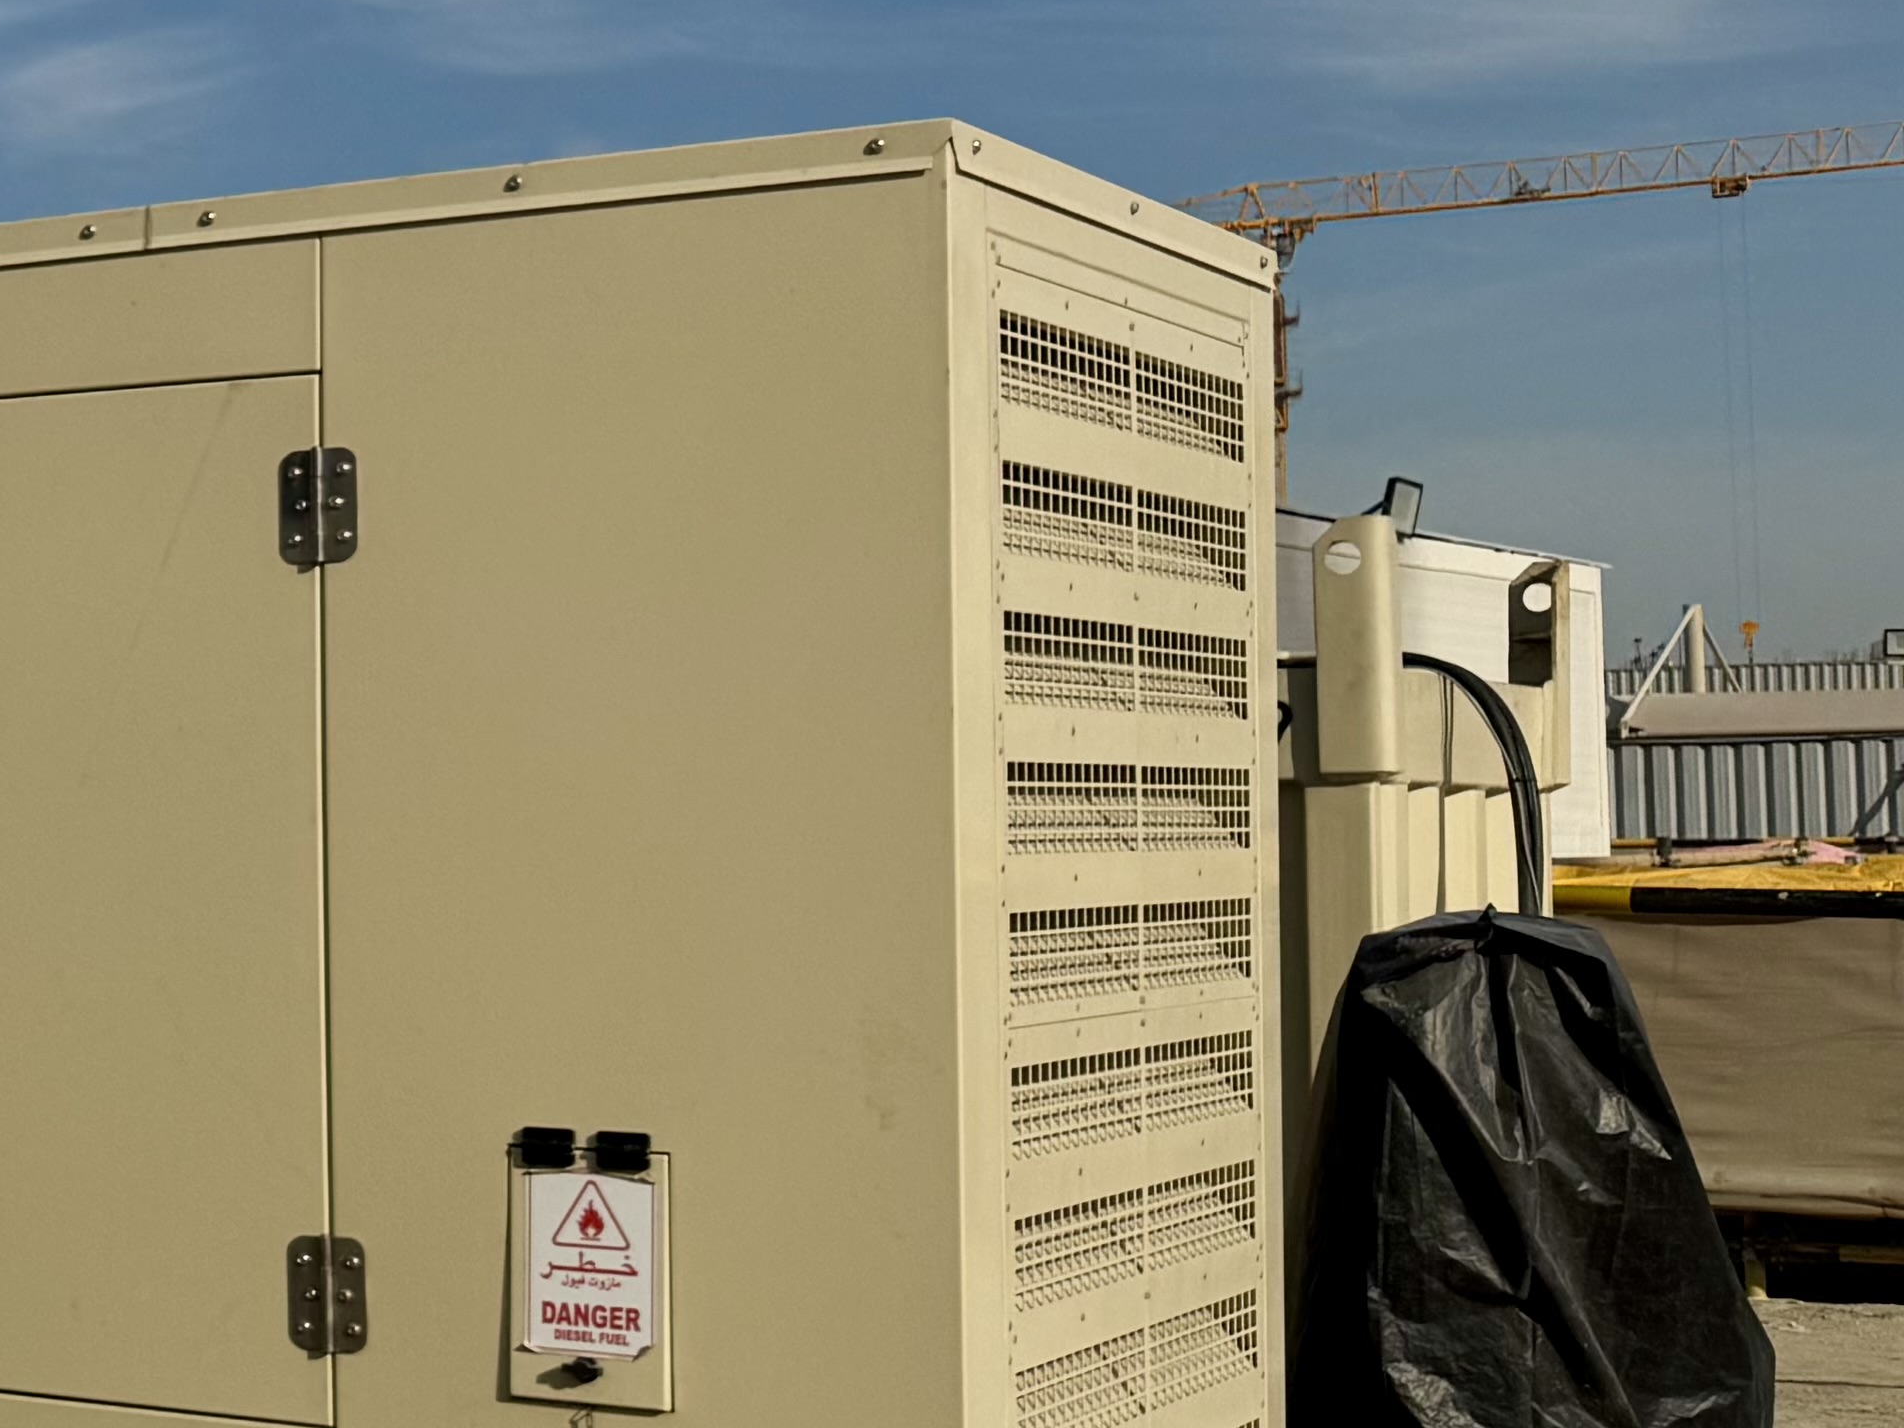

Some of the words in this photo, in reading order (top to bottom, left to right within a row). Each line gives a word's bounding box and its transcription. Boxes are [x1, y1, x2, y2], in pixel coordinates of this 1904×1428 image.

[541, 1300, 641, 1332] DANGER
[554, 1328, 596, 1343] DIESEL
[598, 1332, 630, 1346] FUEL
